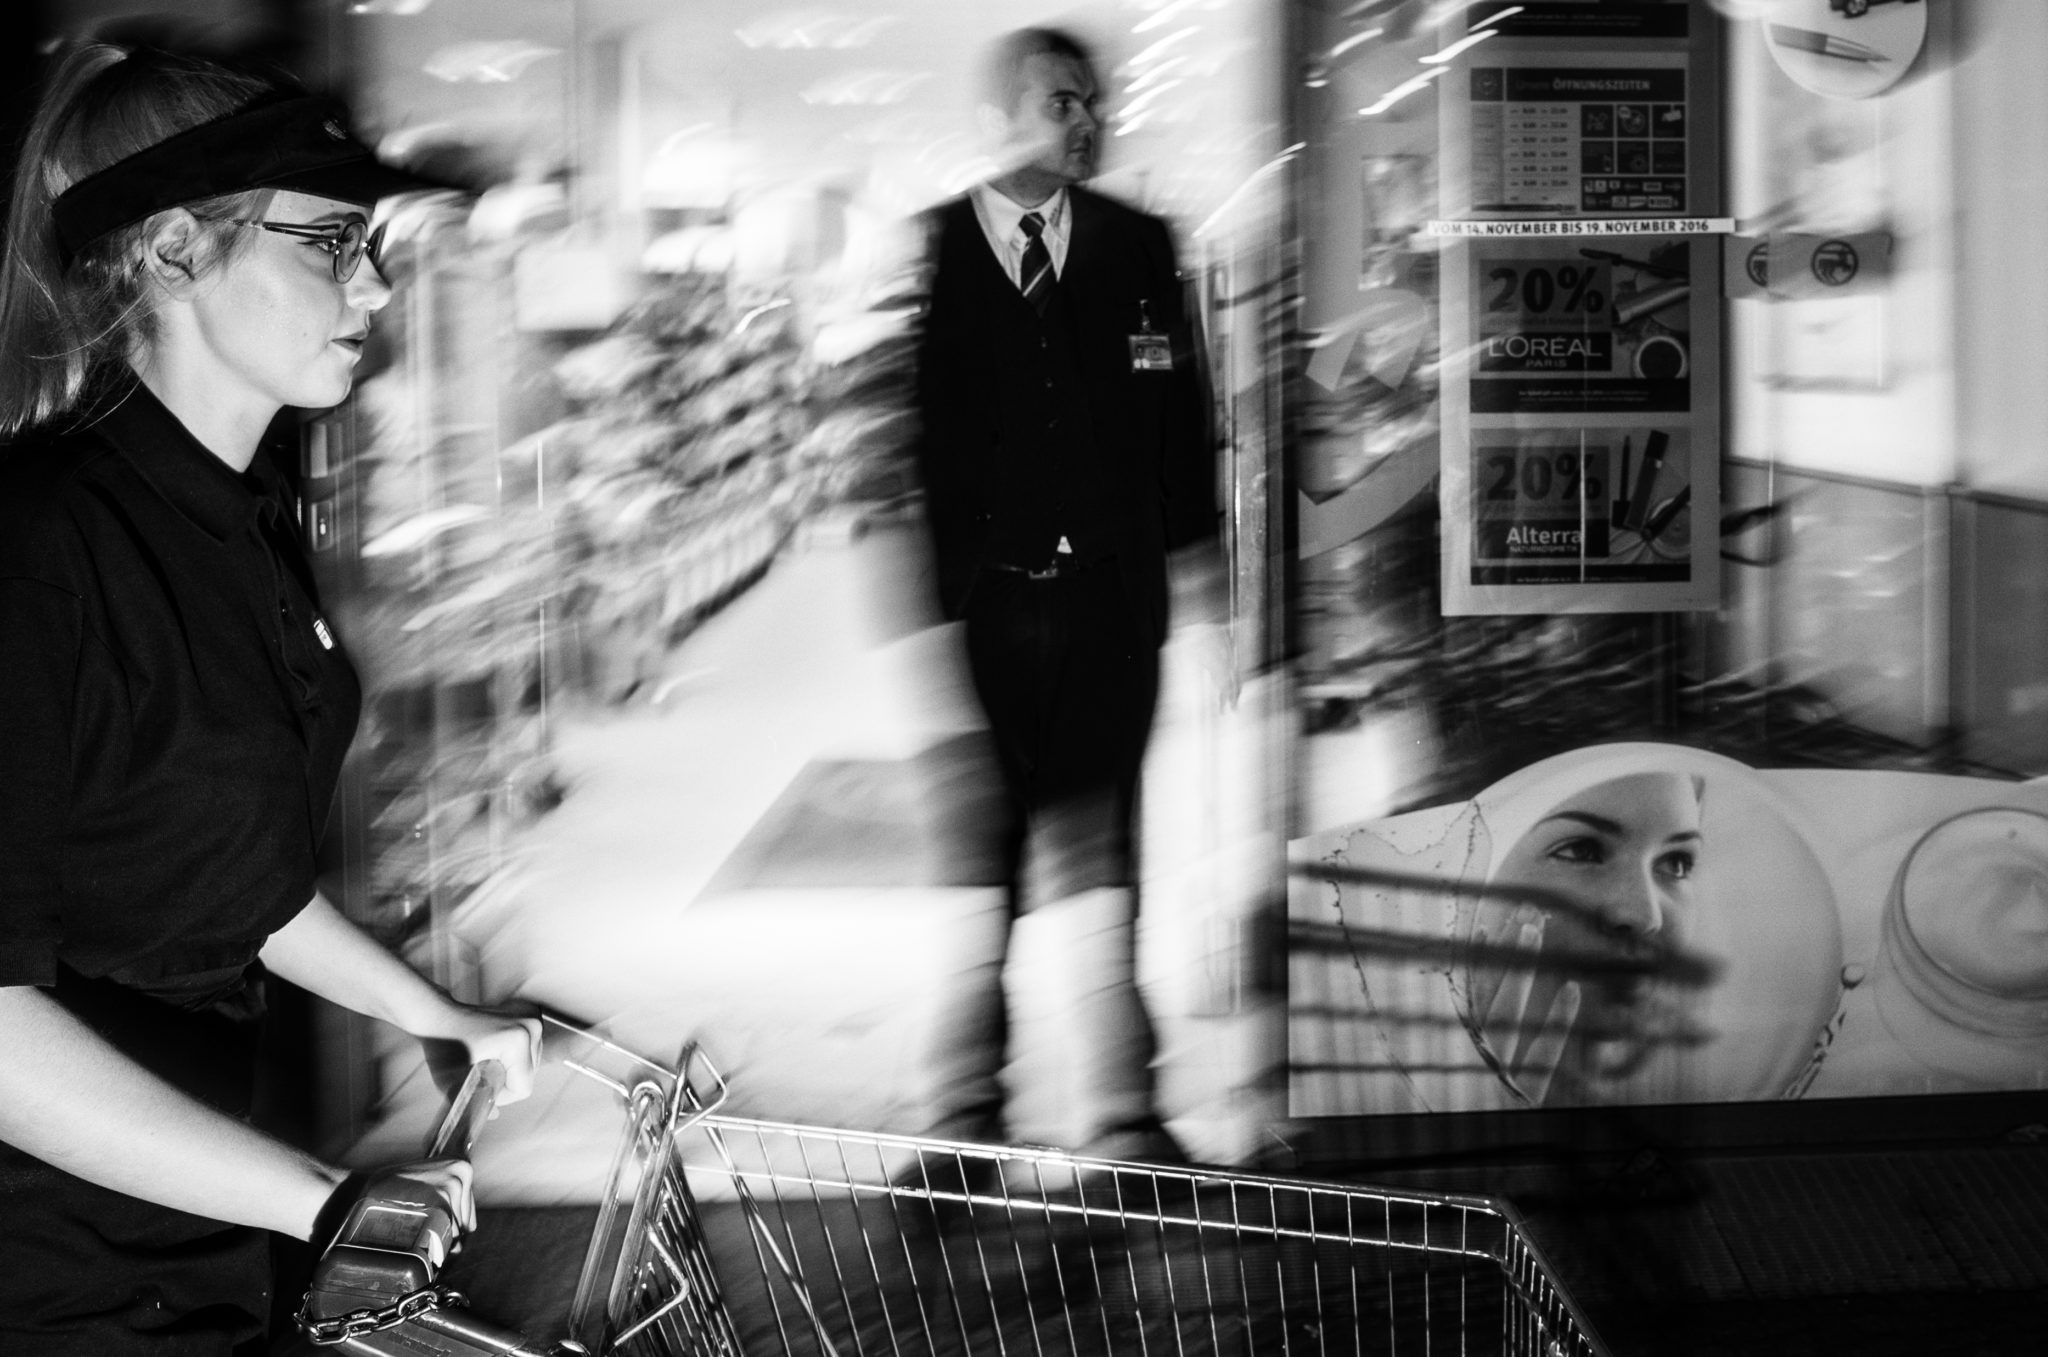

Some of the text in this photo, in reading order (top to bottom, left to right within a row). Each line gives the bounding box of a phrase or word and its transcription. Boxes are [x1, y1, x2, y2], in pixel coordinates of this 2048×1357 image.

[1552, 77, 1650, 90] ÖFFNUNGSZEITEN
[1432, 220, 1709, 234] VOM 14. NOVEMBER BIS 19. NOVEMBER 2016
[1488, 265, 1604, 313] 20%
[1488, 335, 1603, 358] L'ORÉAL
[1525, 359, 1567, 368] PARIS
[1486, 453, 1602, 501] 20%
[1505, 525, 1582, 544] Alterra
